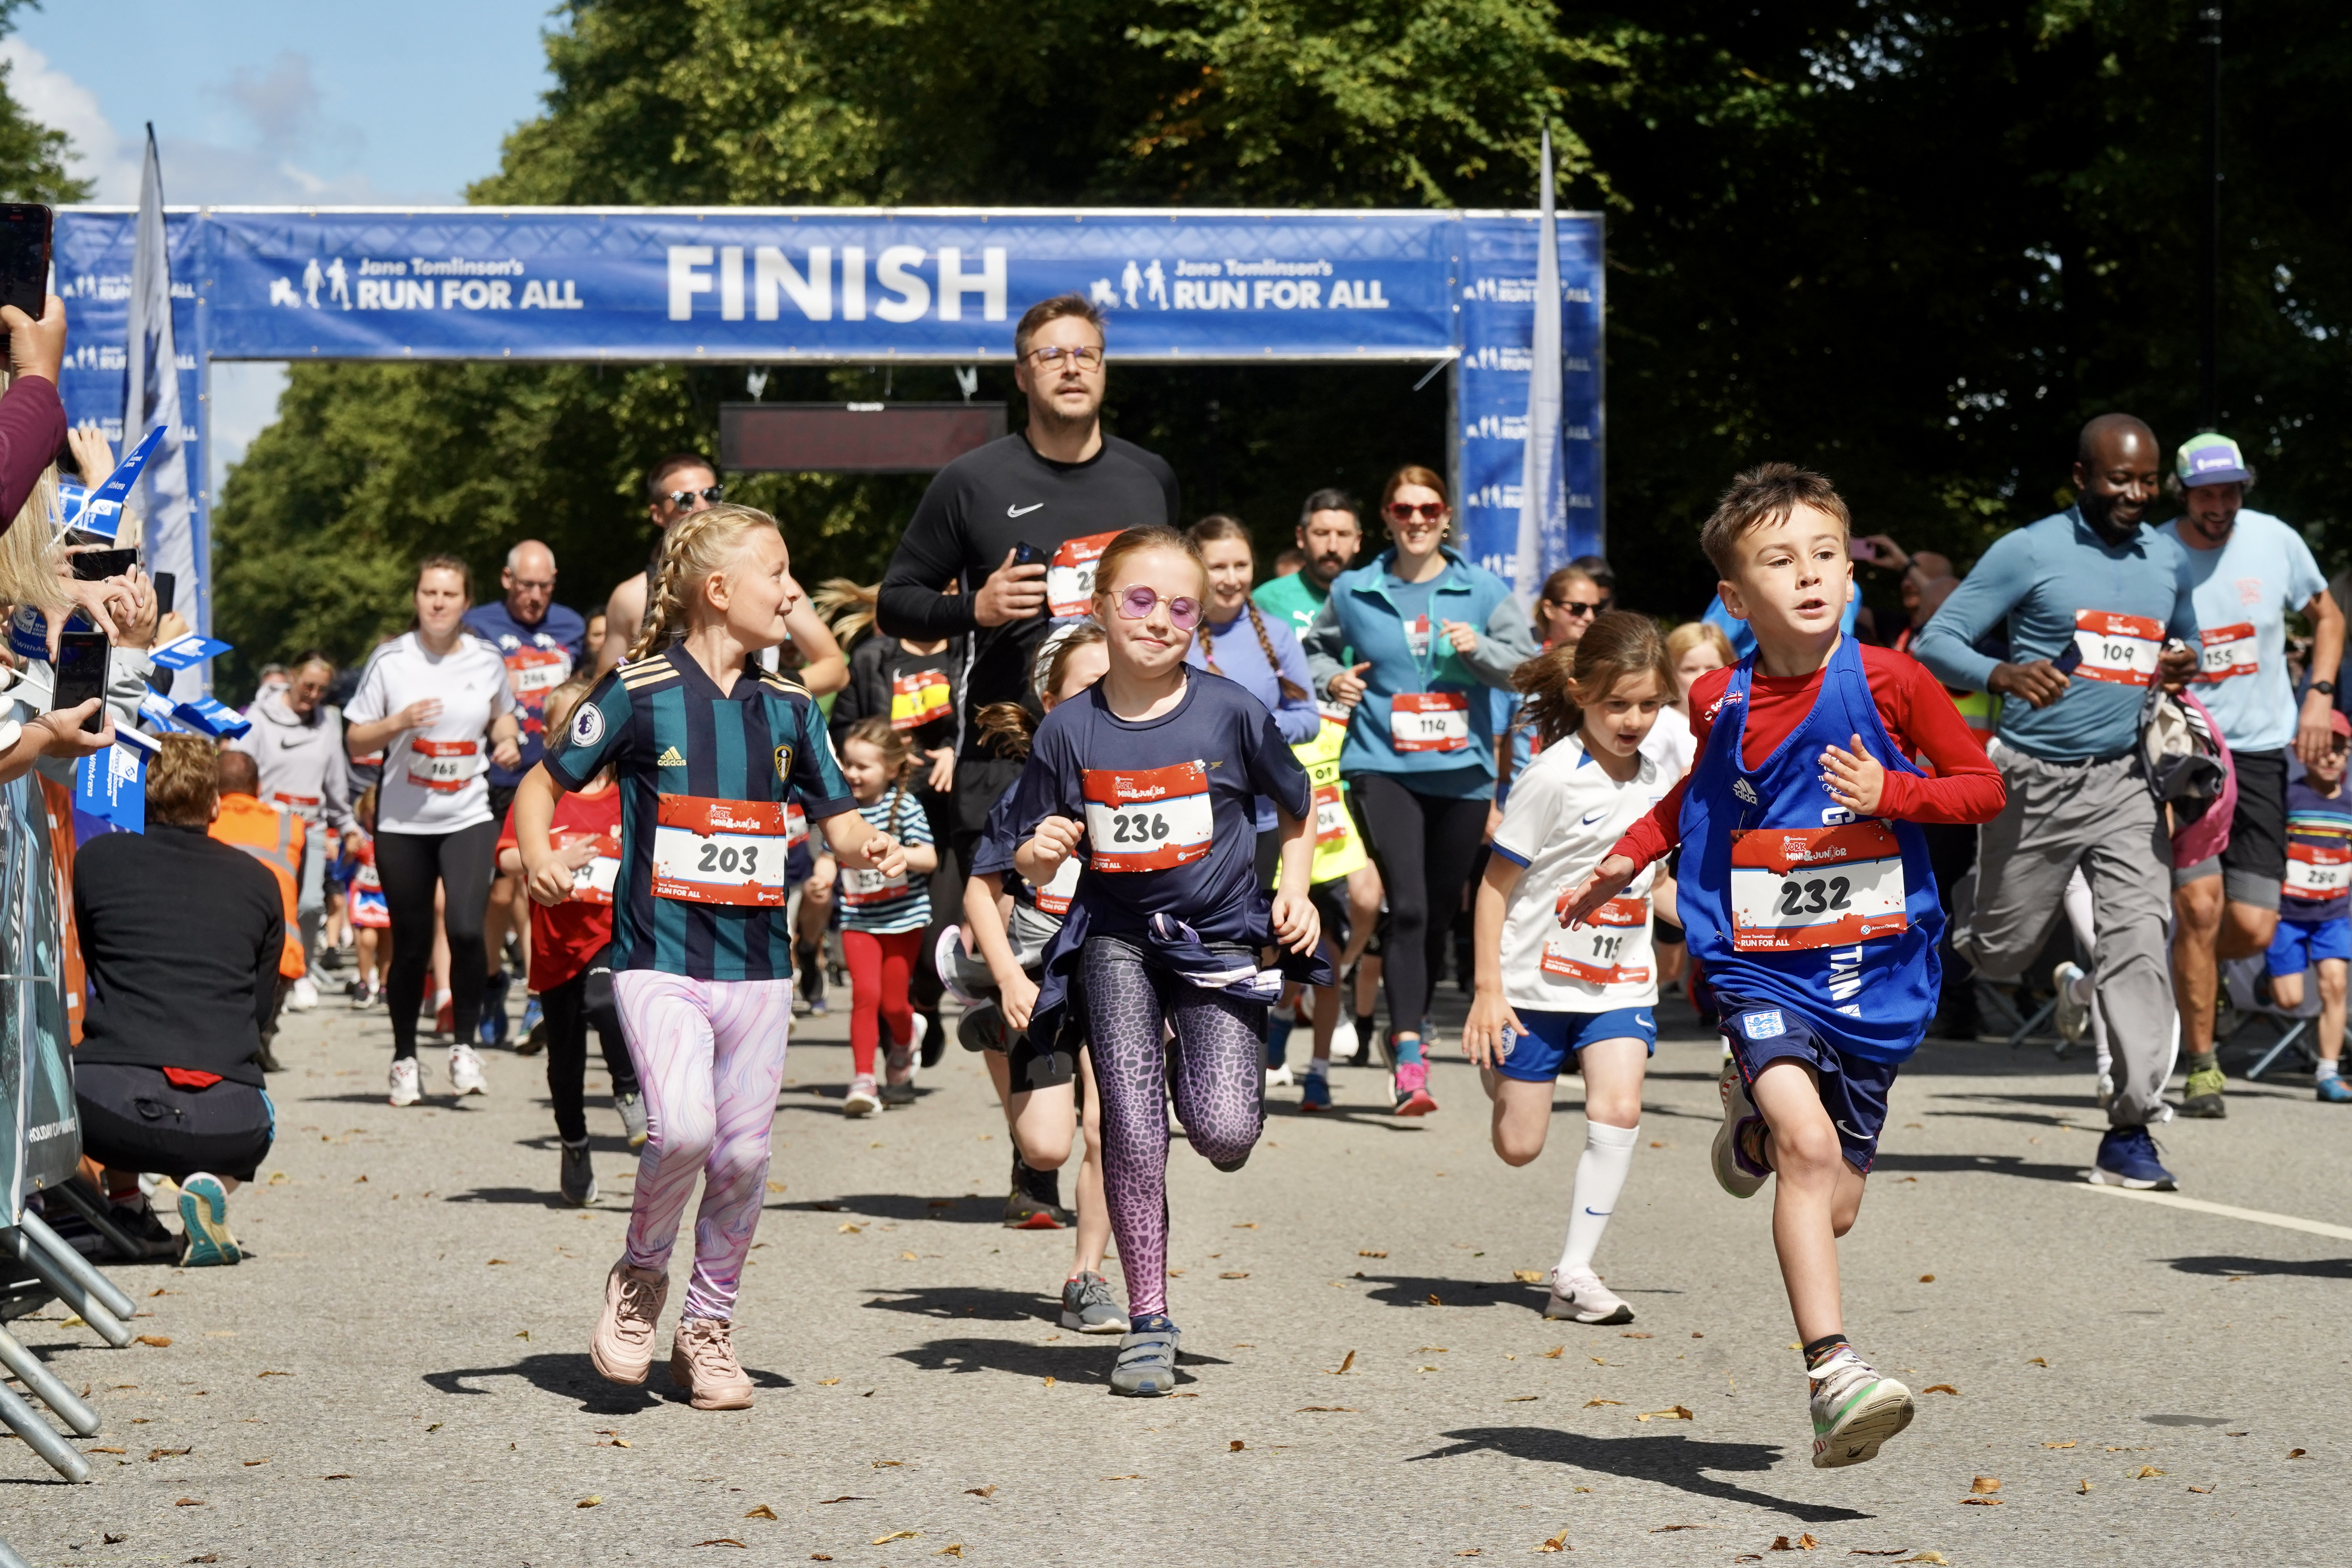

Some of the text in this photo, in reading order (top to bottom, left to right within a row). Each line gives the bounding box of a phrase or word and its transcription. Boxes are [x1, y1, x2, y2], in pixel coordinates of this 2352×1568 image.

[358, 258, 524, 276] Jane Tomlinson's
[1174, 259, 1332, 277] Jane Tomlinson's
[357, 279, 583, 310] RUN FOR ALL
[668, 245, 1007, 323] FINISH
[1174, 279, 1389, 310] RUN FOR ALL
[2103, 643, 2134, 663] 109
[2207, 650, 2232, 664] 155
[1421, 719, 1445, 732] 114
[87, 754, 96, 797] WithArena
[710, 810, 730, 819] YORK
[1114, 813, 1169, 842] 236
[698, 843, 758, 875] 203
[1784, 842, 1806, 852] YORK
[1781, 877, 1851, 915] 232
[1593, 935, 1622, 960] 115
[1829, 943, 1862, 1001] TAIN
